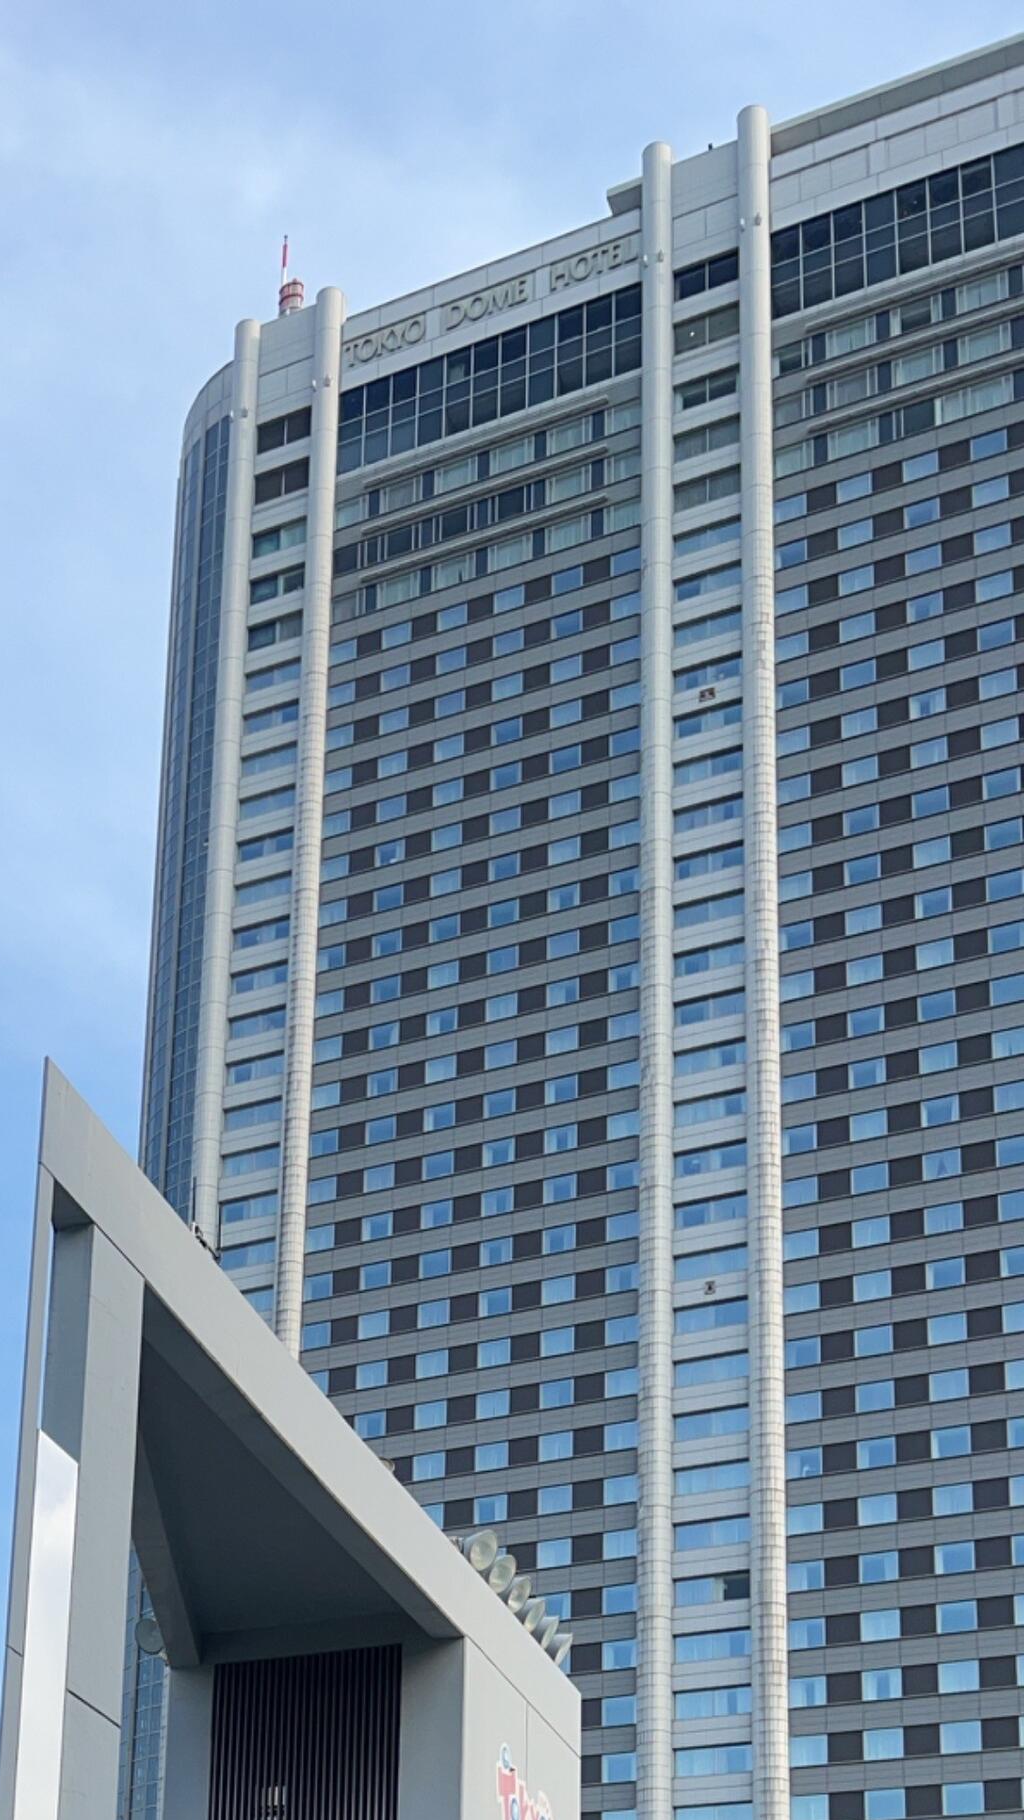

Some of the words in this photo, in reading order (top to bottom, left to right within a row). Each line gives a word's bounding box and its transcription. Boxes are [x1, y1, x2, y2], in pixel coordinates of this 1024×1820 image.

[344, 319, 426, 367] TOKYO
[445, 279, 530, 331] DOME
[550, 242, 640, 291] HOTEL
